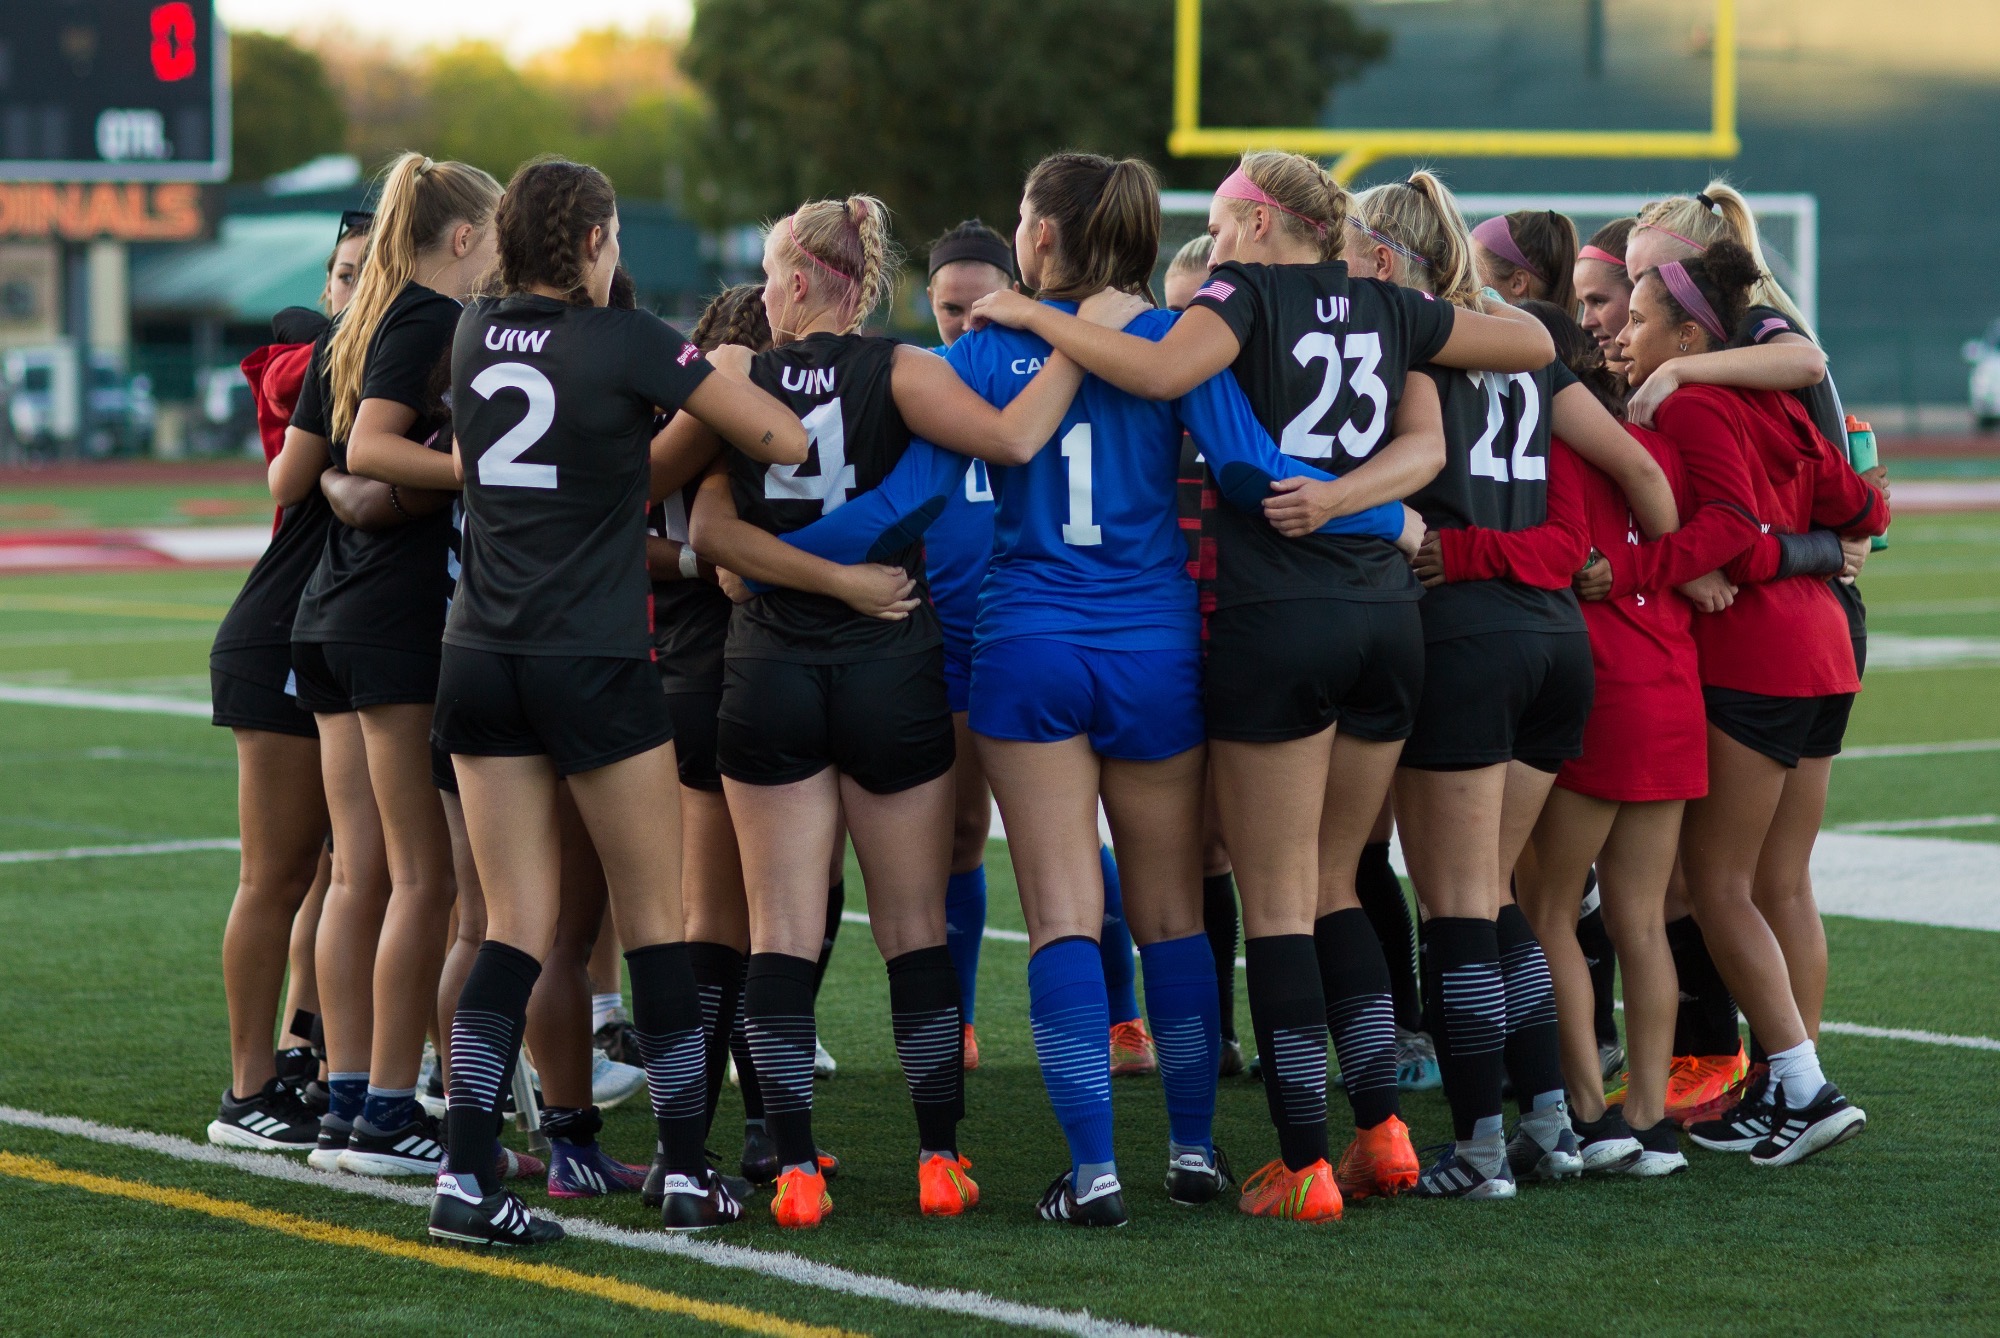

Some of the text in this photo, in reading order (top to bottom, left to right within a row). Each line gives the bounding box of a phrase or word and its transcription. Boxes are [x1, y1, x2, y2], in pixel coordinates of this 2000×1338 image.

[485, 325, 551, 353] UIW
[1280, 331, 1388, 458] 23
[470, 362, 558, 489] 2
[765, 396, 857, 516] 4
[1061, 422, 1103, 546] 1
[1180, 1160, 1204, 1168] adidas
